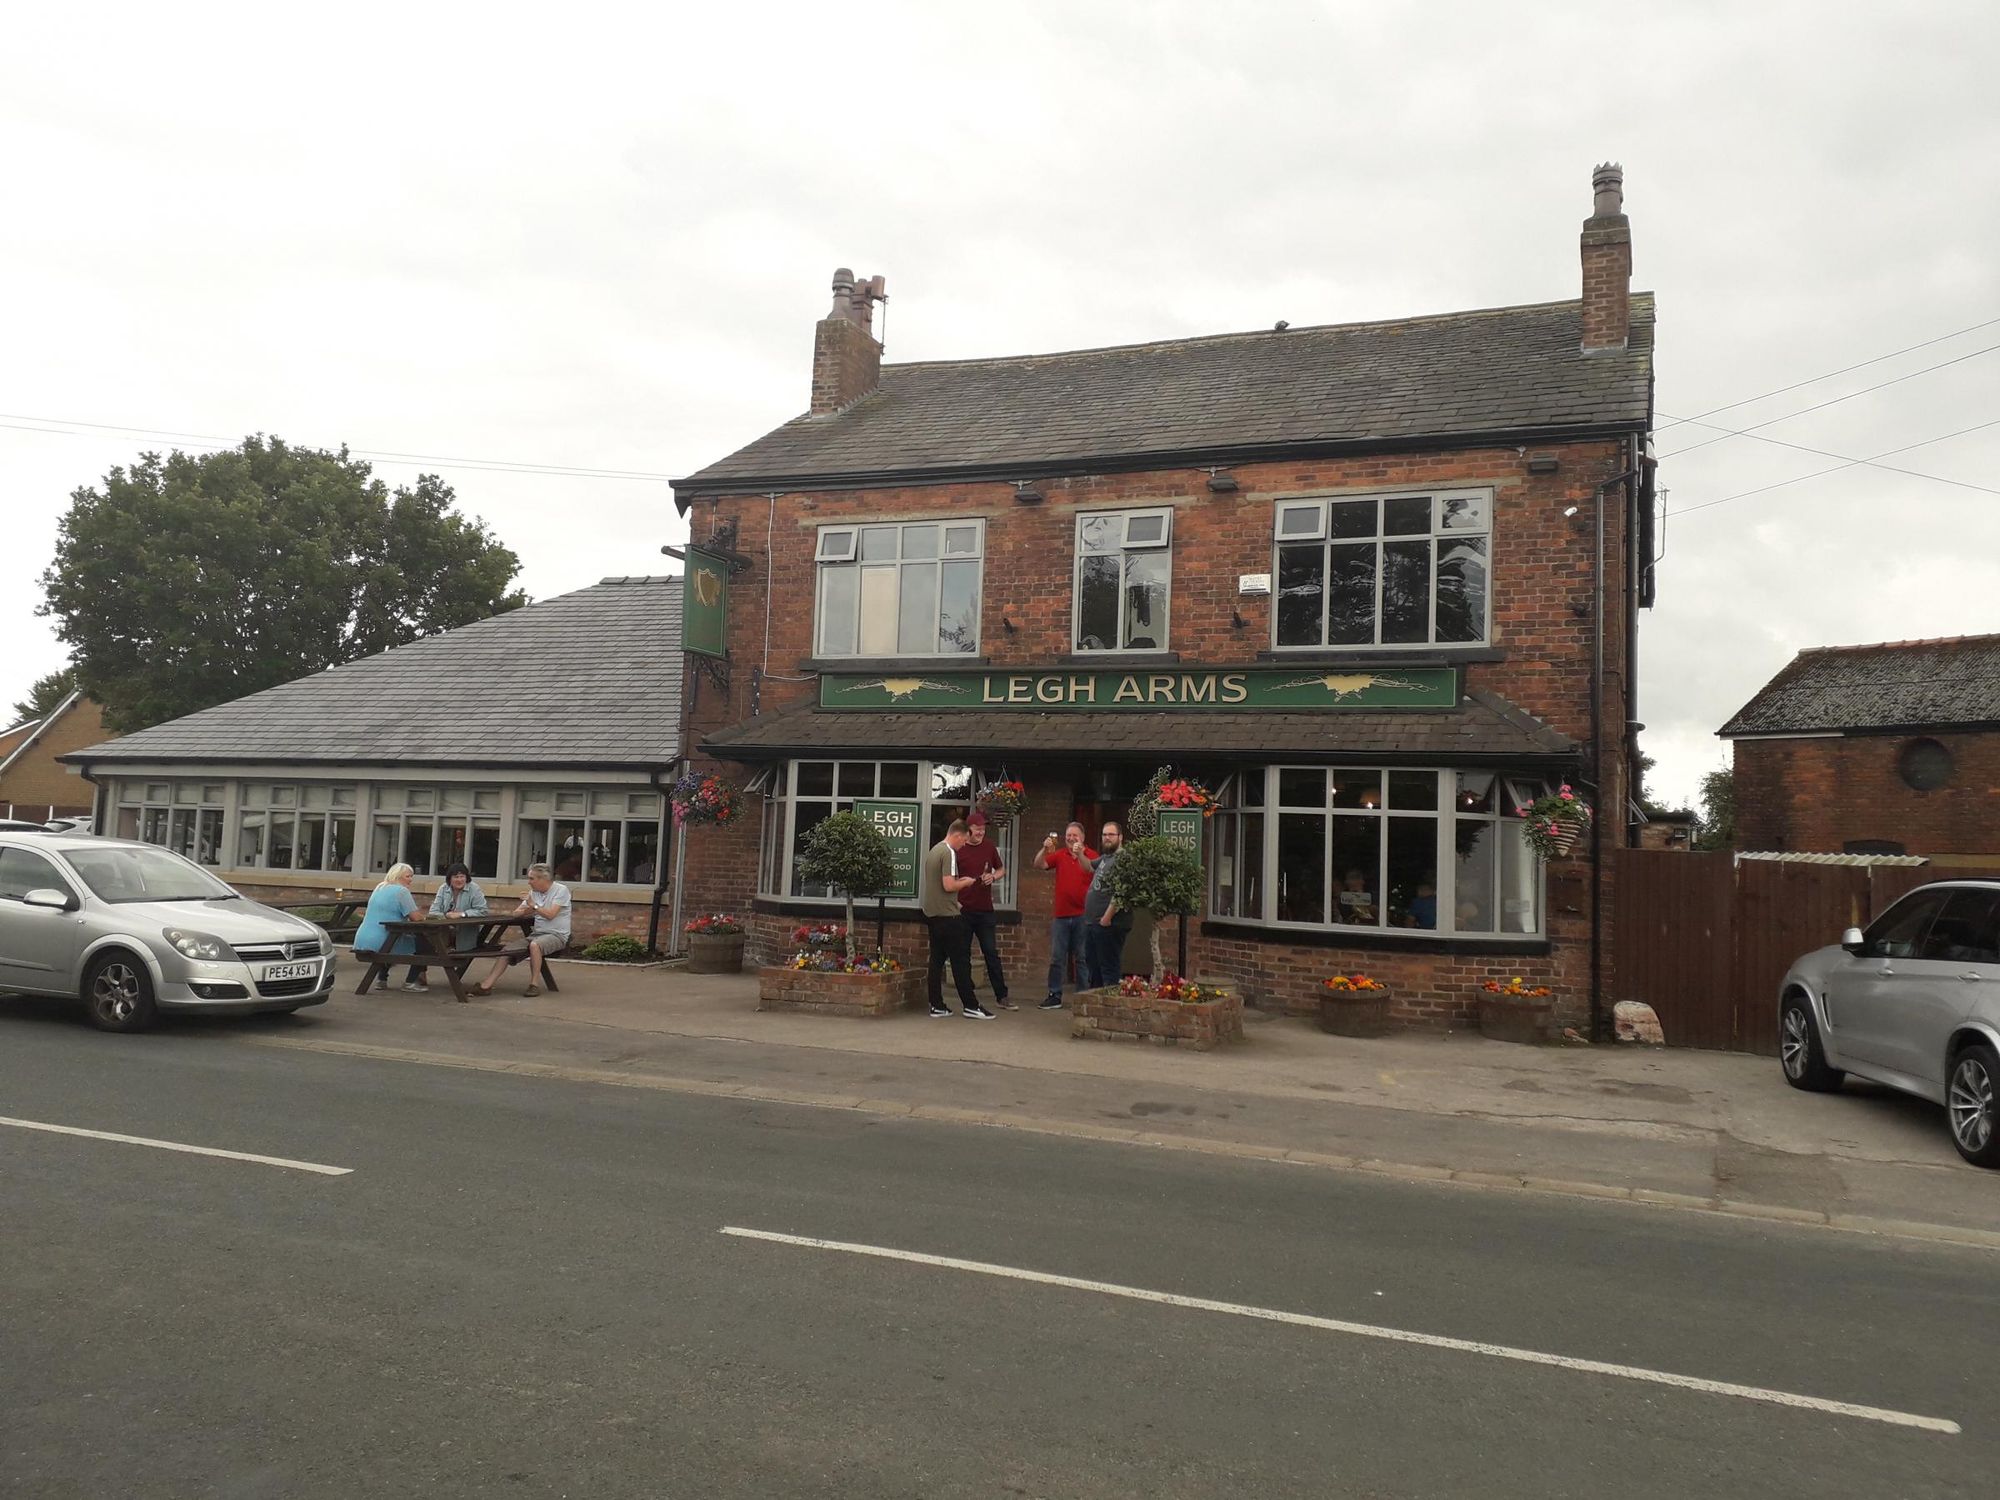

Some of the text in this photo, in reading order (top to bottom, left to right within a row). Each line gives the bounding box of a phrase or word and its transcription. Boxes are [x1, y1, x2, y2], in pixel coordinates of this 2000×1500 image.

[982, 674, 1248, 703] LEGH ARMS
[863, 810, 912, 824] LEGH
[874, 825, 914, 838] RMS
[1163, 820, 1195, 834] LEGH
[1170, 836, 1196, 850] RMS
[893, 863, 912, 871] OOD
[269, 964, 311, 978] PE54 XSA
